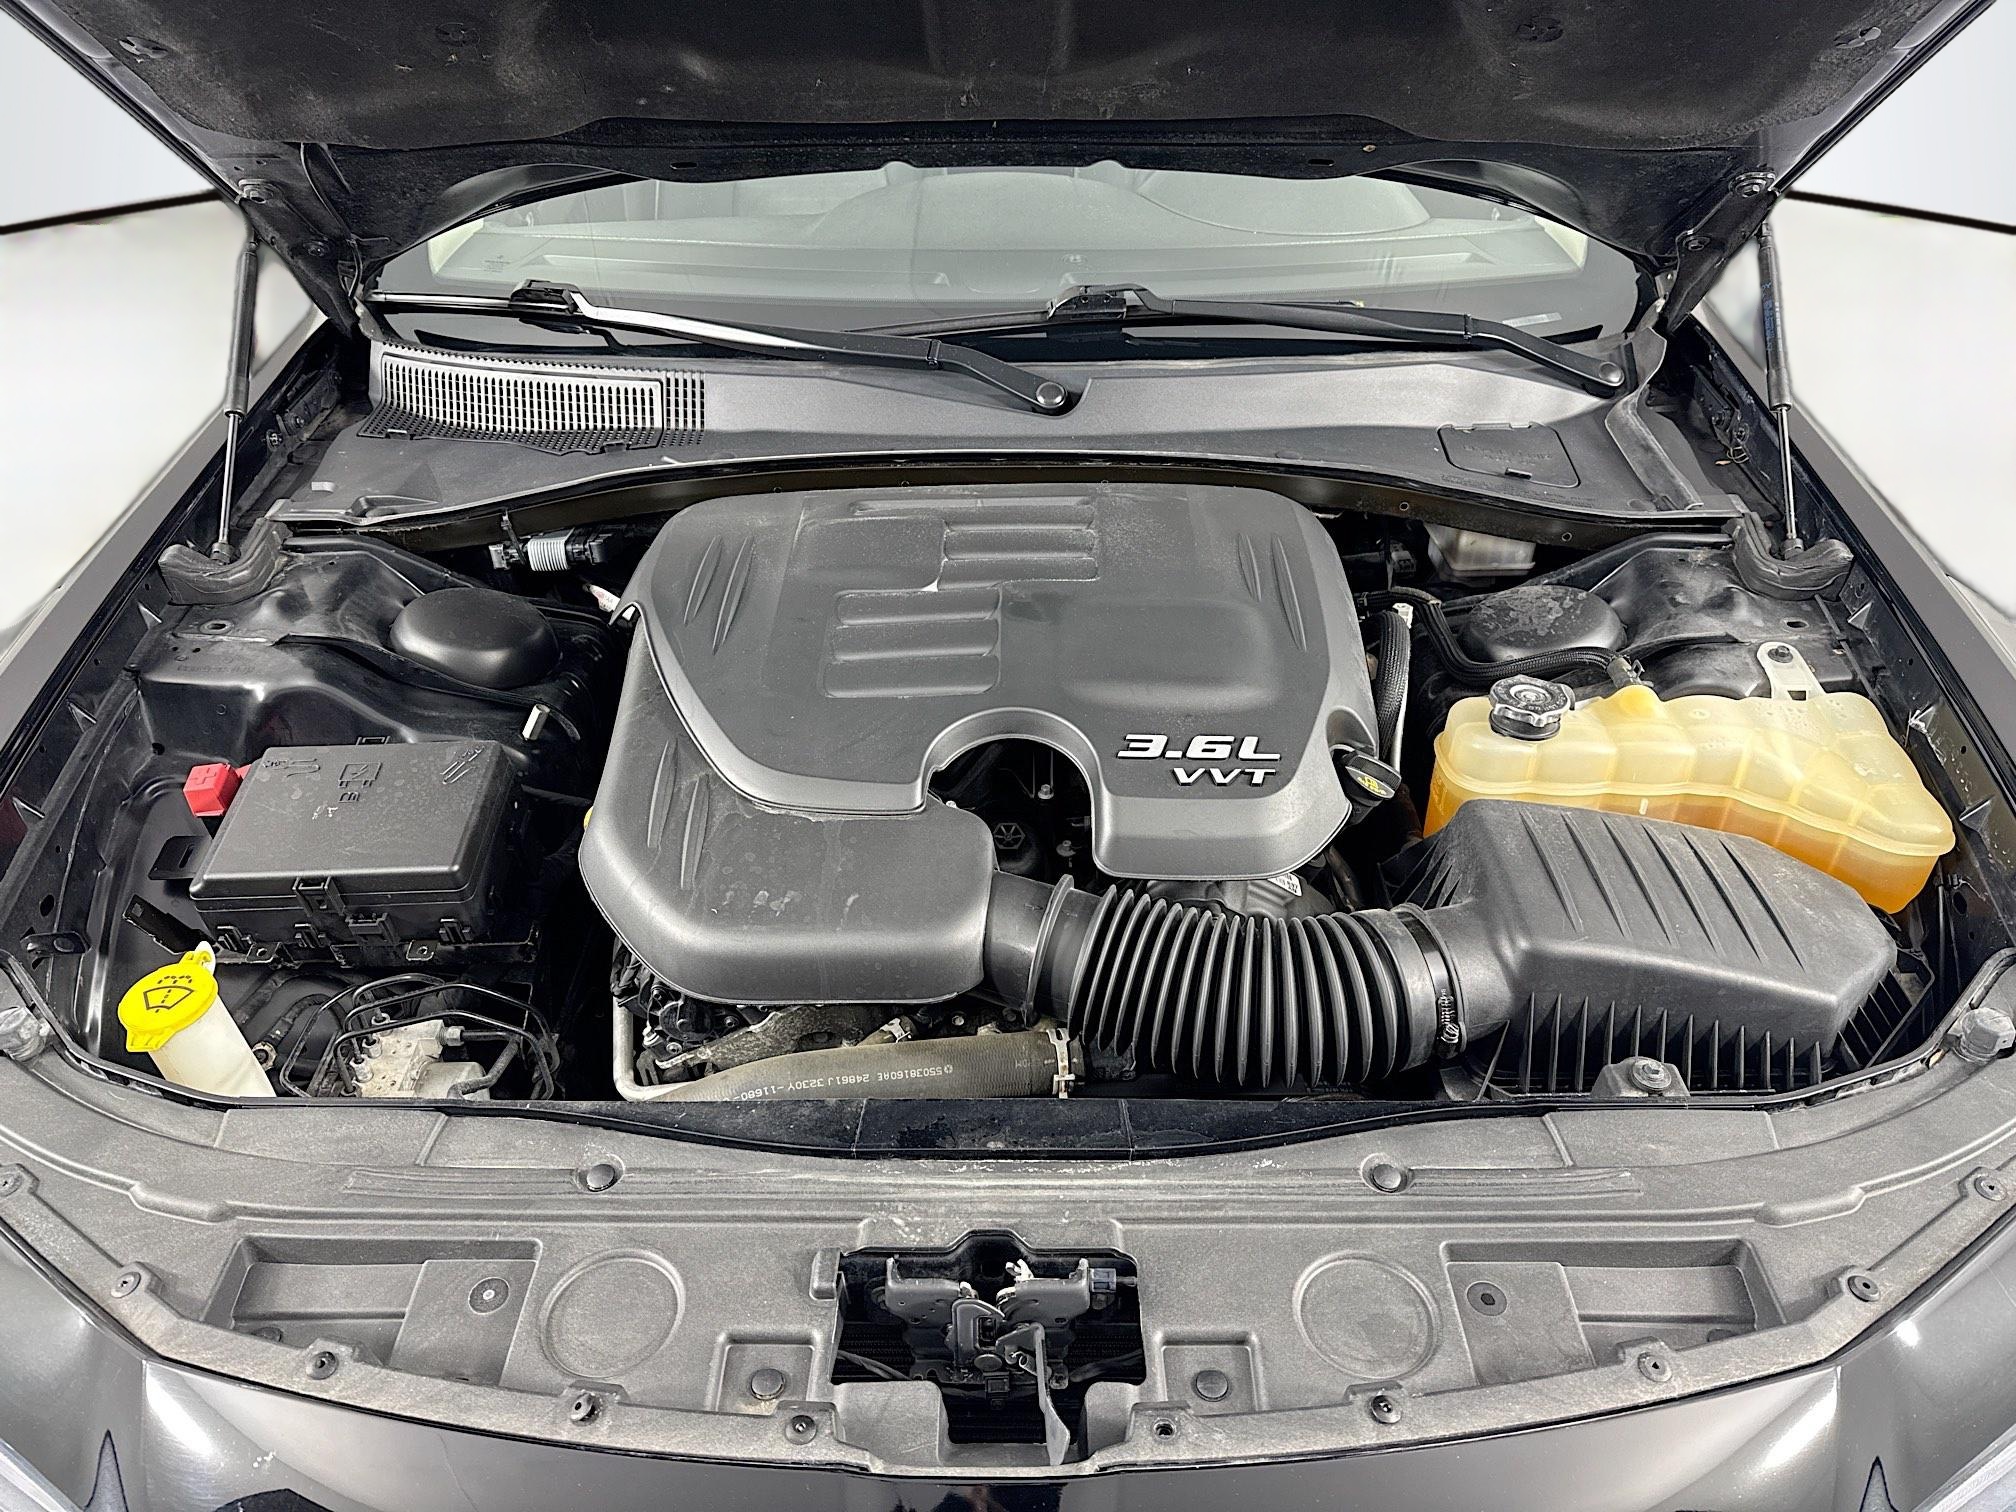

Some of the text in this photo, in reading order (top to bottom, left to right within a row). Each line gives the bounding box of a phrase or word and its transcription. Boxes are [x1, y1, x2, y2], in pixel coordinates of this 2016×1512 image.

[1117, 734, 1281, 760] 3.6L
[1172, 767, 1276, 787] VVT
[877, 1066, 943, 1082] 55038160AE
